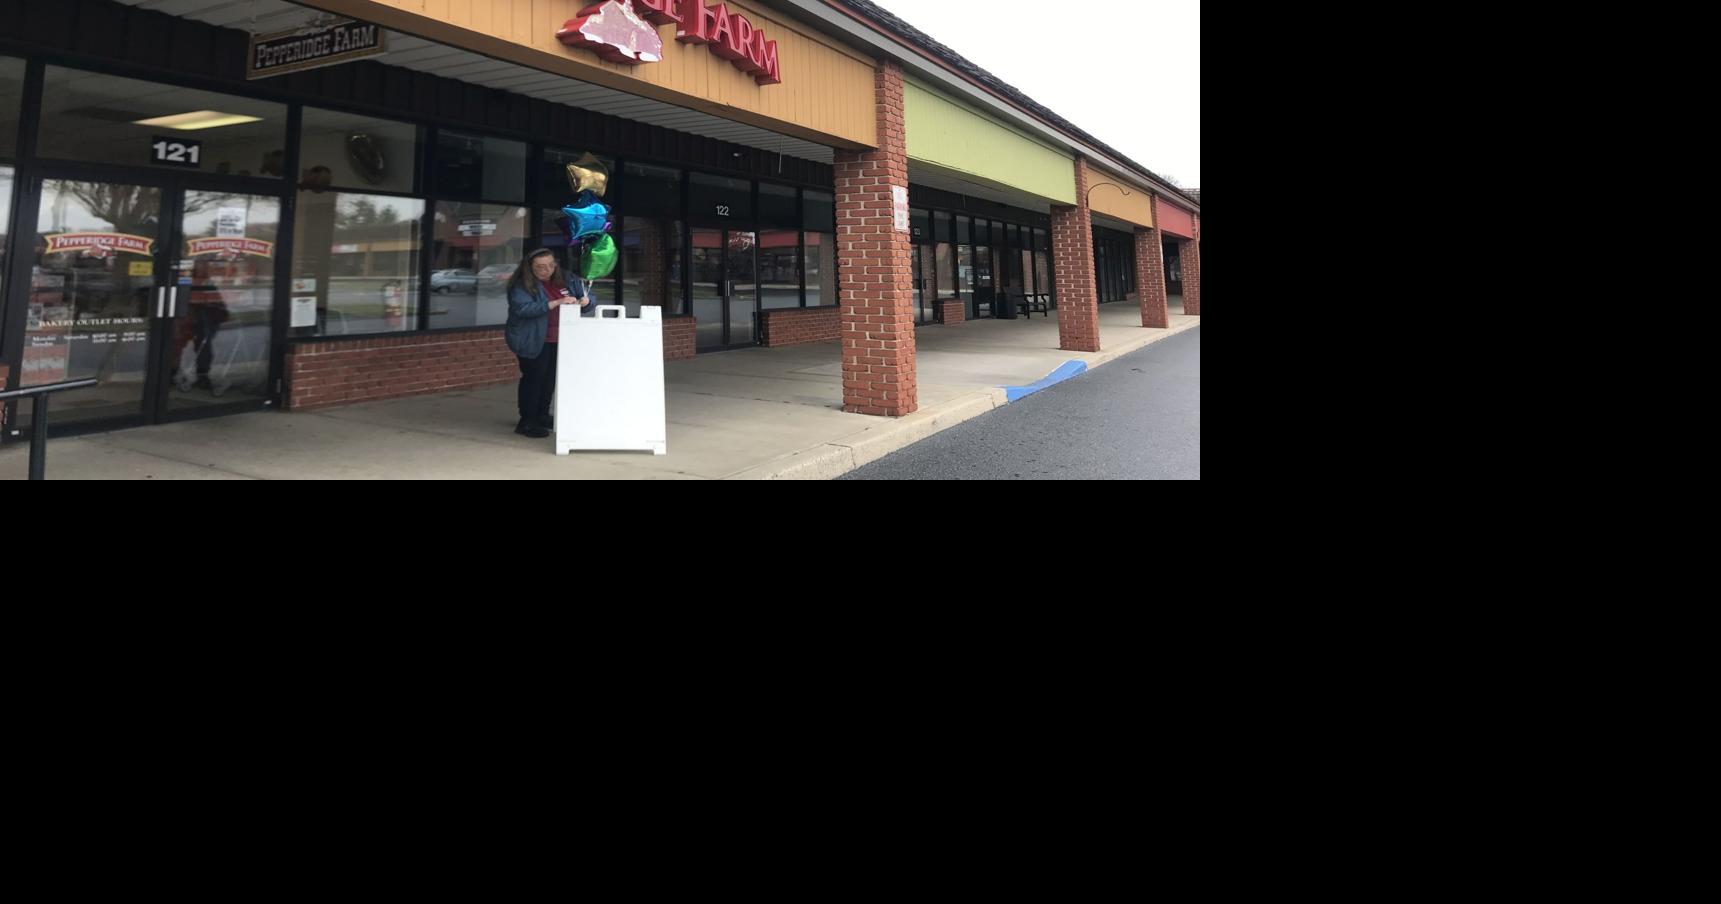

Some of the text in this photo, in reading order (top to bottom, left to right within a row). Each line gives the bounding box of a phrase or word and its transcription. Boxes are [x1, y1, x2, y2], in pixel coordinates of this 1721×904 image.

[255, 25, 375, 68] PEPPERIDGE FARM
[153, 141, 200, 163] 121
[716, 205, 729, 216] 122
[55, 236, 145, 249] PEPPERIDGE FARM
[76, 318, 112, 326] OUTLET
